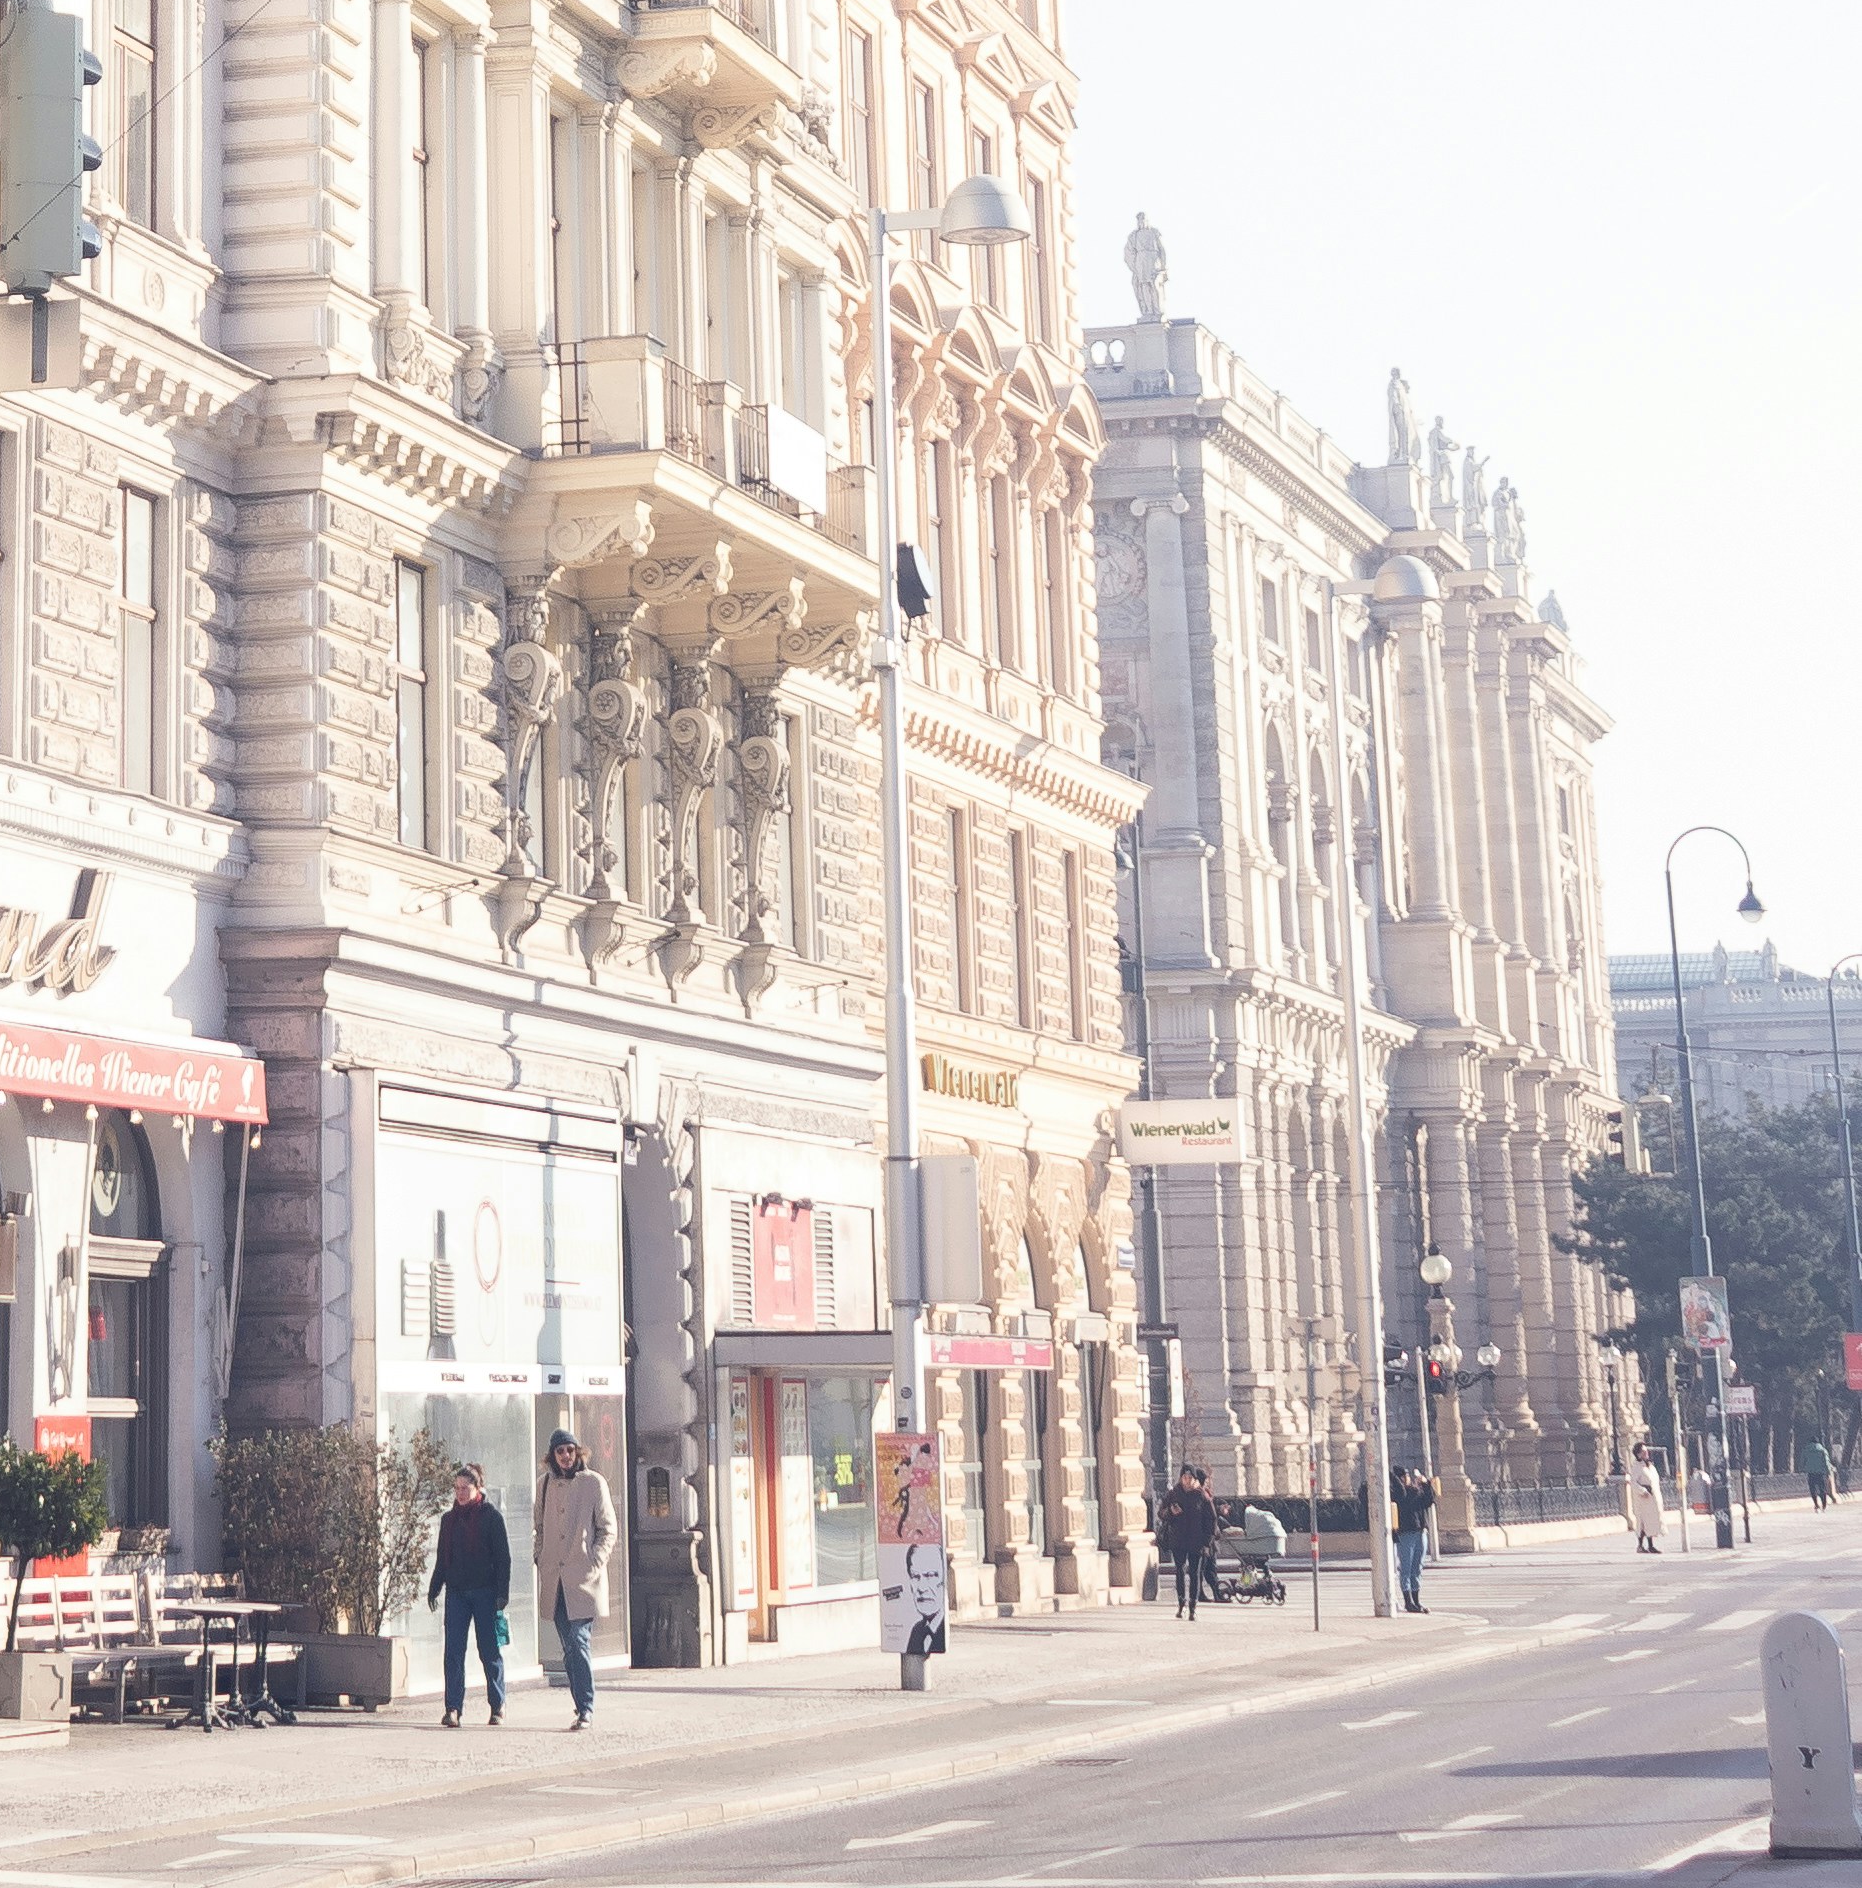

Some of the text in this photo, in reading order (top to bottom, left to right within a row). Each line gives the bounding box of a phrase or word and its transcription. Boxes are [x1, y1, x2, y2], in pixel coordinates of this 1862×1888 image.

[99, 1050, 172, 1101] Wiener
[173, 1060, 223, 1111] Café
[1130, 1120, 1215, 1136] Wienerwald
[1181, 1136, 1233, 1146] Restaurant
